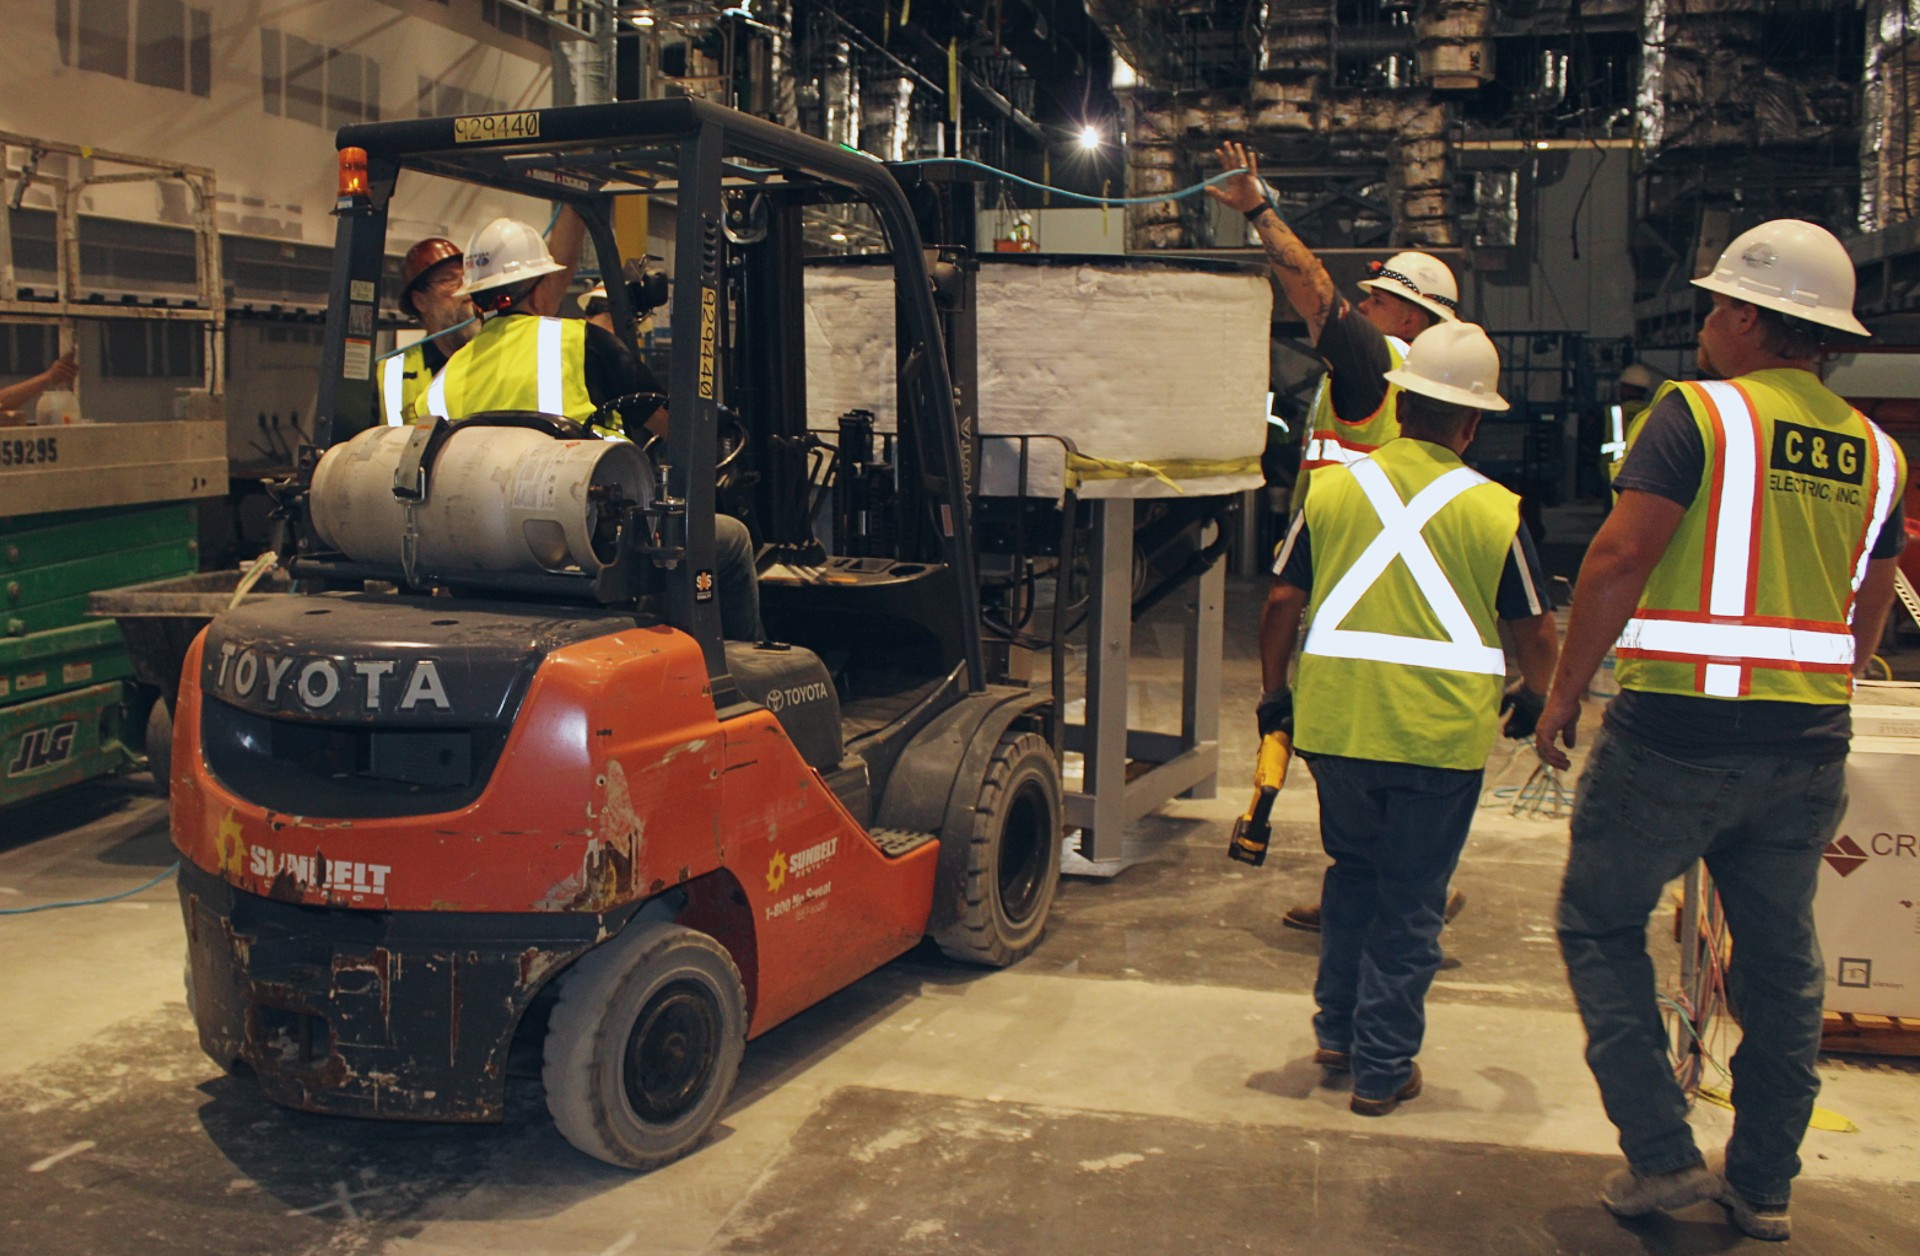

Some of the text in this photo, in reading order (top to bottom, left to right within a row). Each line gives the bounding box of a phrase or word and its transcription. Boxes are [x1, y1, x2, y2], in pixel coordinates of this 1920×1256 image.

[456, 113, 537, 140] 929440
[700, 291, 716, 396] 929440
[1785, 430, 1857, 475] C & G
[217, 641, 450, 709] TOYOTA
[784, 682, 828, 706] TOYOTA
[8, 721, 77, 777] JLG
[789, 837, 838, 873] SUNBELT
[1871, 832, 1920, 858] CR
